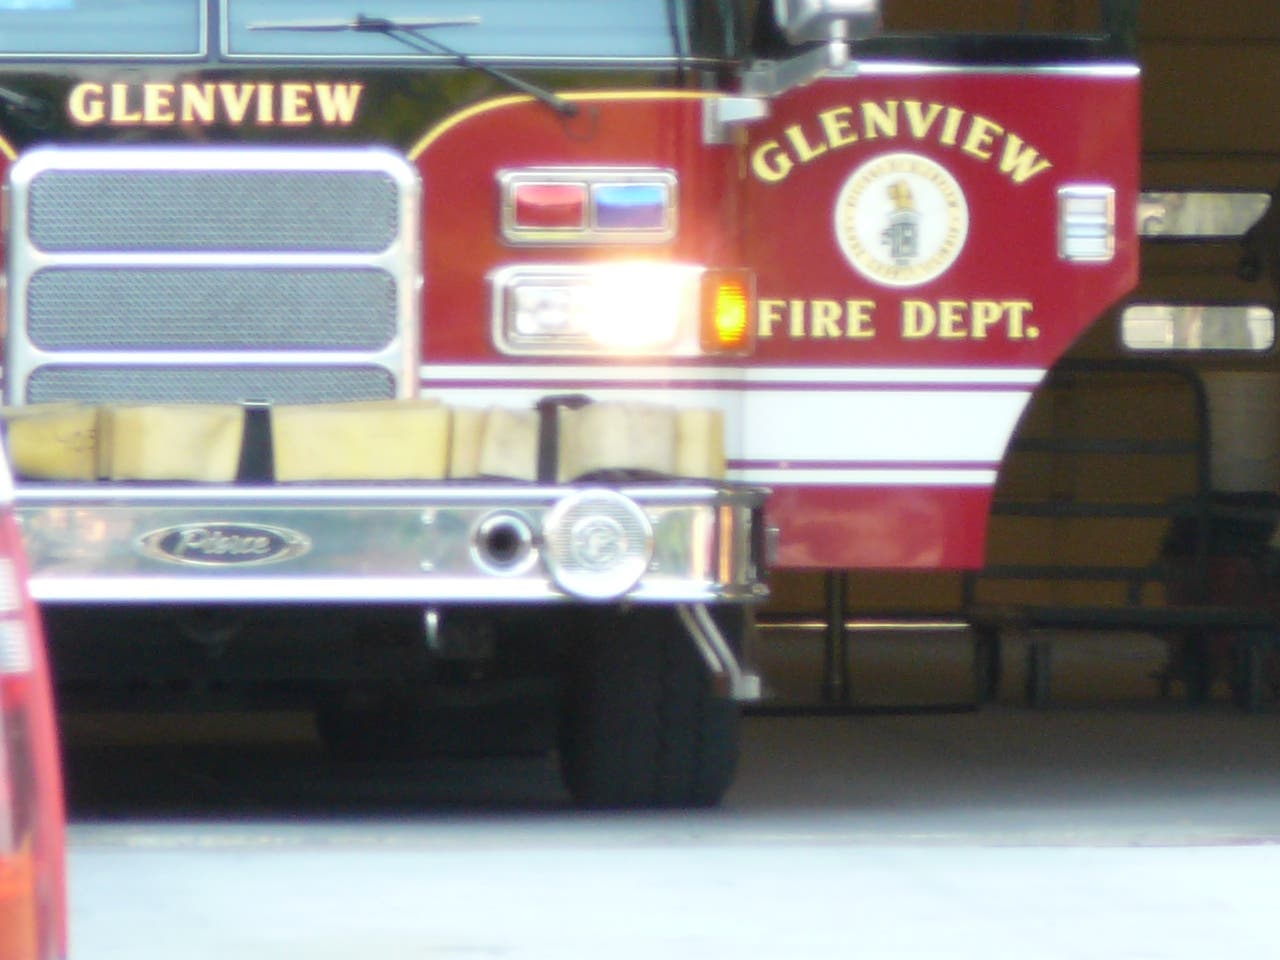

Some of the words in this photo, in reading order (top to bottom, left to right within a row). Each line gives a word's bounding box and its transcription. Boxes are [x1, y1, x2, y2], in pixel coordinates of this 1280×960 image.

[68, 82, 366, 124] GLENVIEW
[751, 100, 1053, 184] GLENVIEW
[757, 299, 876, 339] FIRE
[902, 299, 1040, 340] DEPT.
